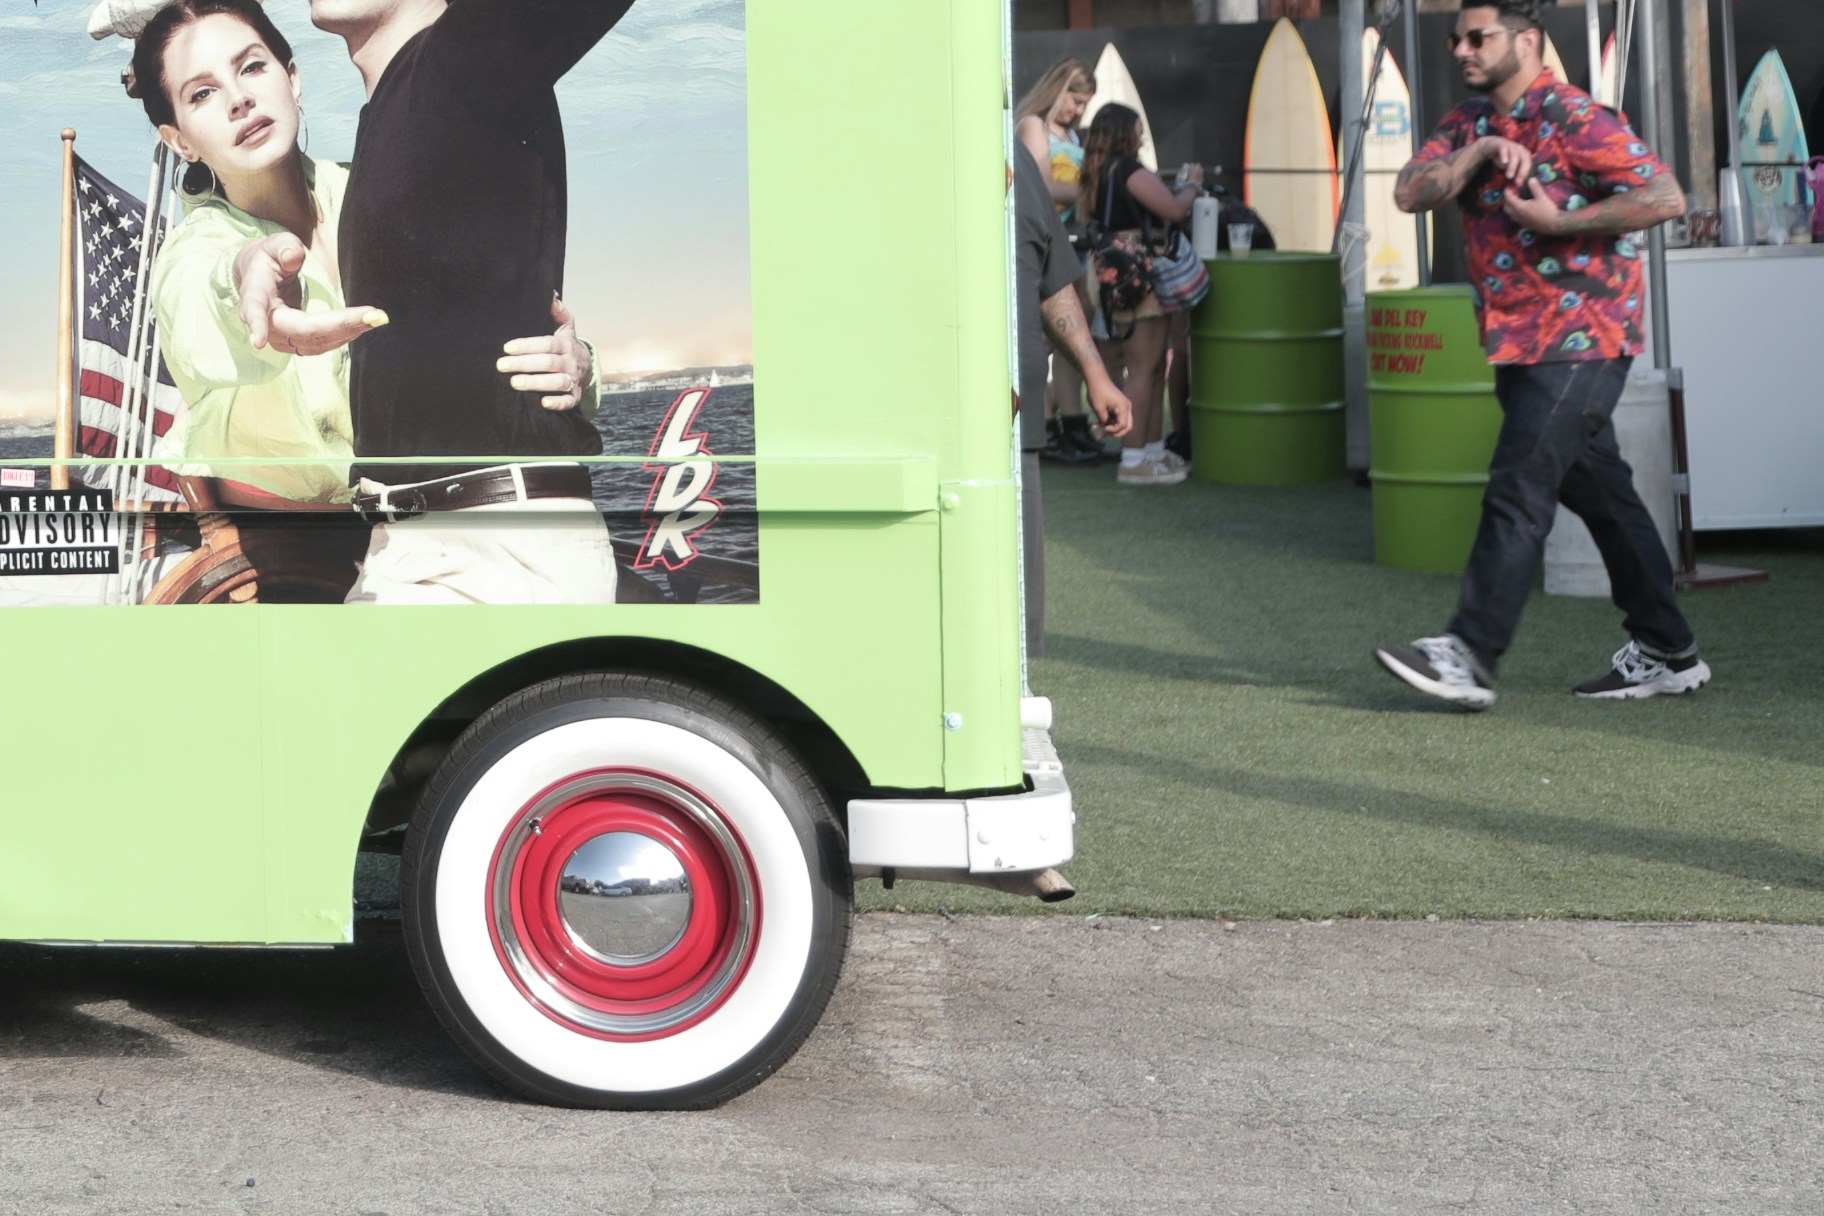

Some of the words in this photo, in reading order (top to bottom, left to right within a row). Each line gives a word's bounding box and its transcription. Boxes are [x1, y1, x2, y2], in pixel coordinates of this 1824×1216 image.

[1404, 308, 1428, 328] REY
[1388, 353, 1425, 374] NOW!
[640, 389, 723, 567] LDR
[51, 550, 111, 569] CONTENT
